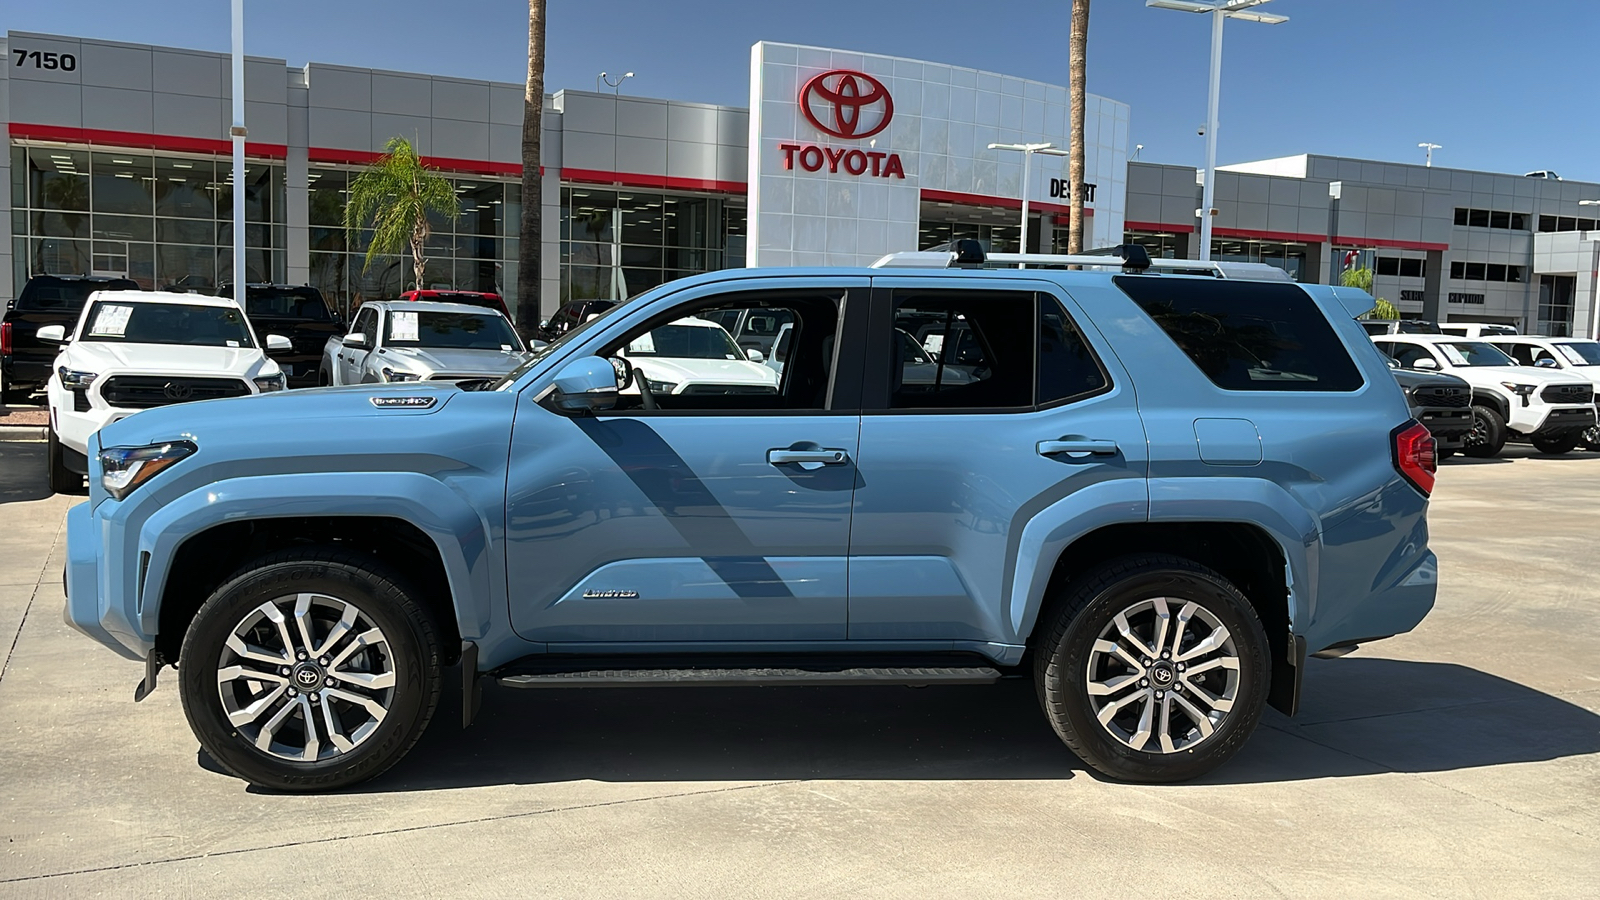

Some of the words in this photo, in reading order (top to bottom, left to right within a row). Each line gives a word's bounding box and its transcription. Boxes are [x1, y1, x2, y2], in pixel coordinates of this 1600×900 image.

[12, 48, 76, 72] 7150
[779, 143, 906, 179] TOYOTA
[1050, 177, 1097, 203] DERT
